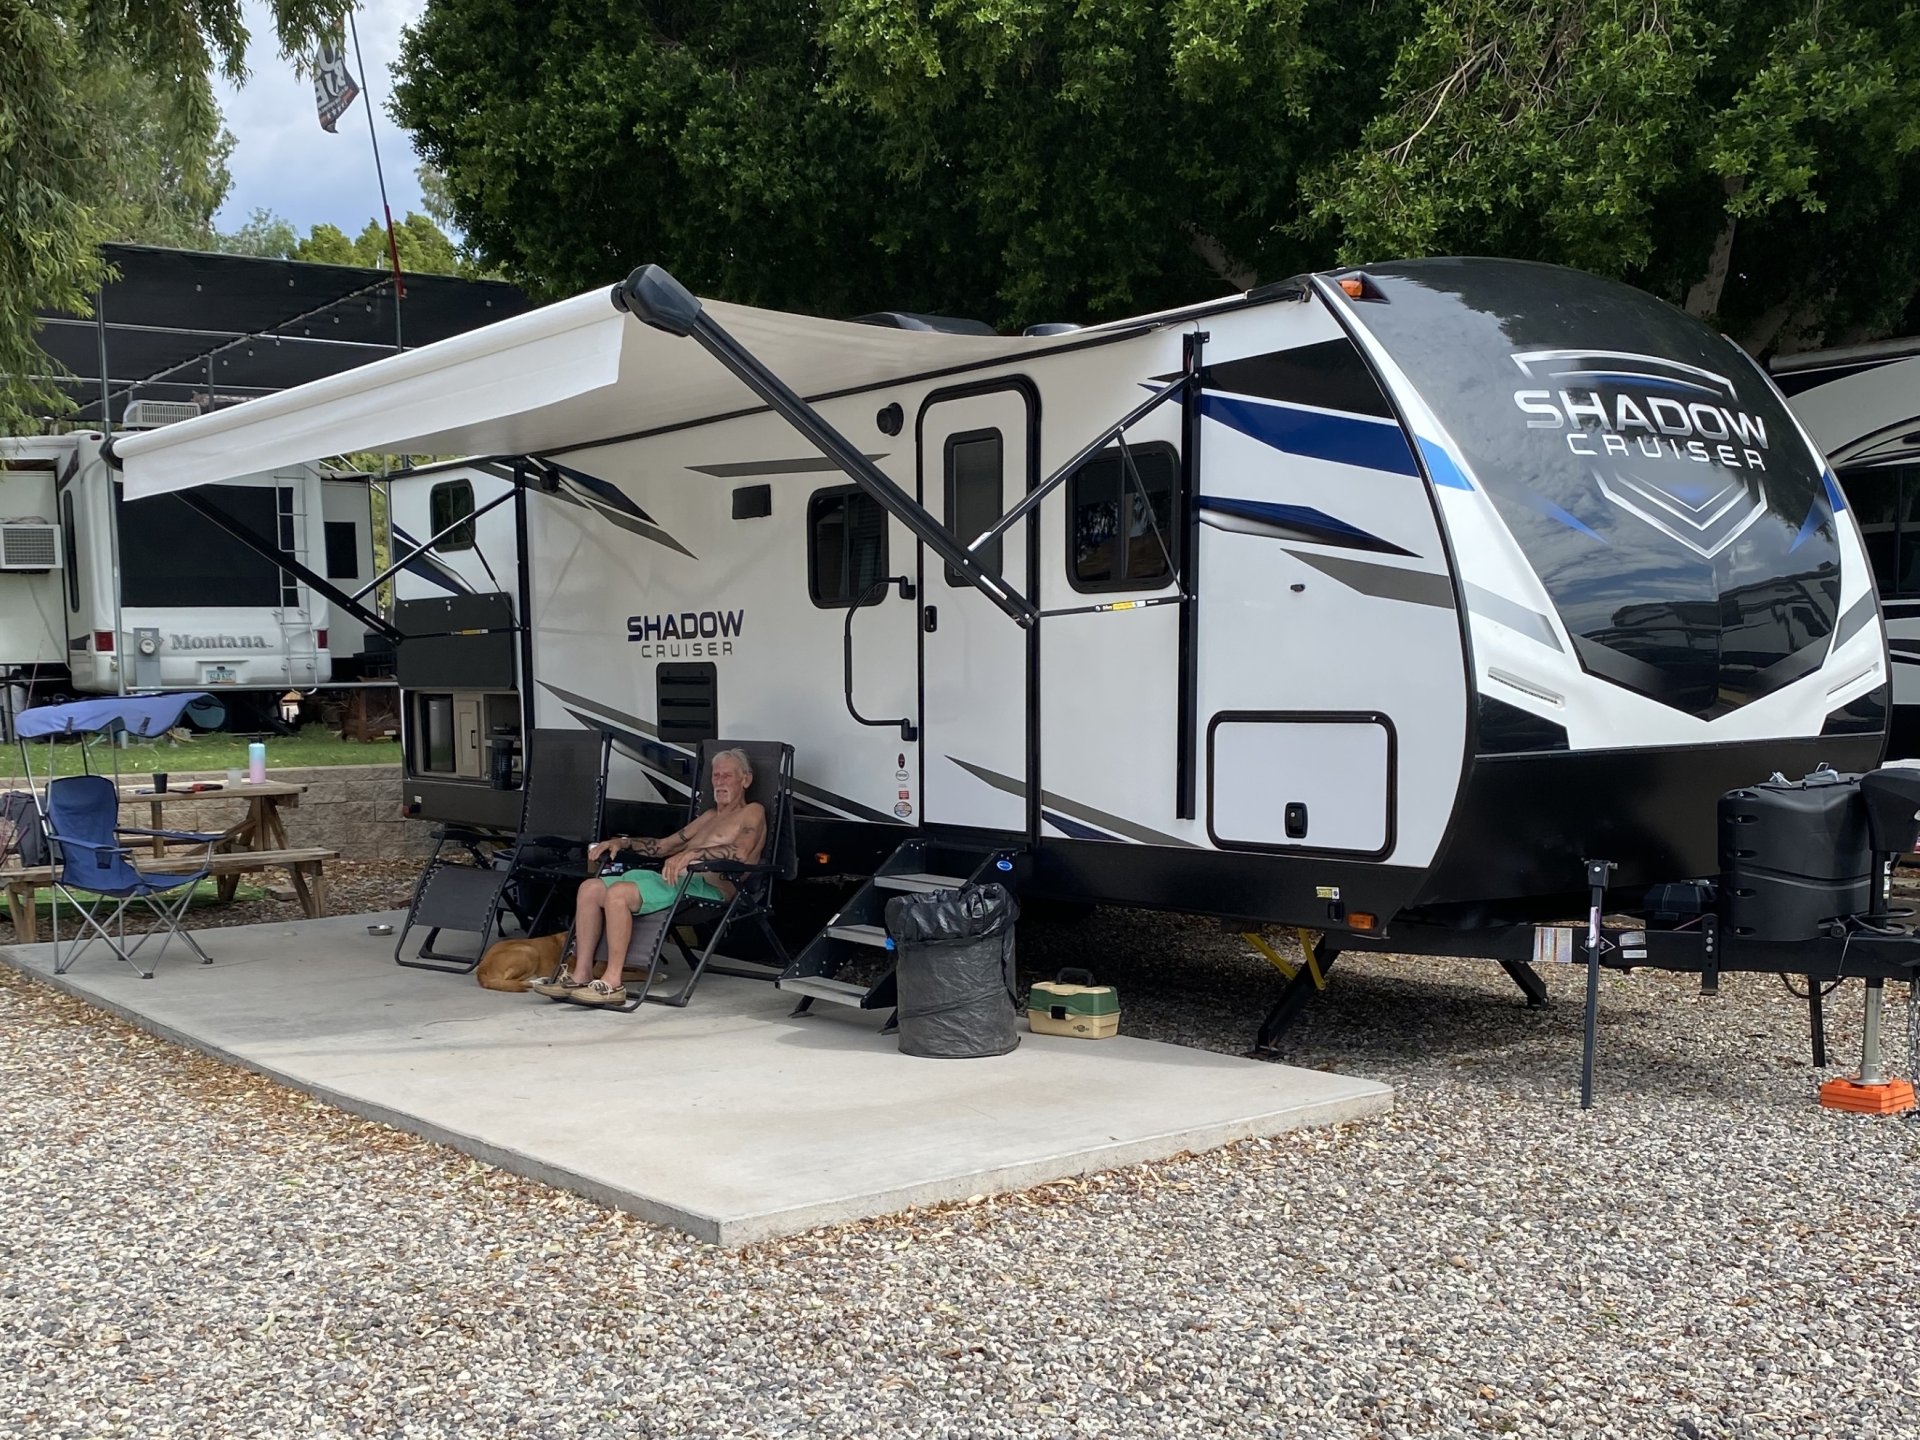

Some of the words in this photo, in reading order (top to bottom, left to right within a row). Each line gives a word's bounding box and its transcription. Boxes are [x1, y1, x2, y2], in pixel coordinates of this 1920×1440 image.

[1513, 390, 1769, 450] SHADOW
[1566, 433, 1767, 472] CRUISER
[169, 633, 267, 650] Montana
[627, 609, 744, 642] SHADOW
[641, 641, 733, 658] CRUISER
